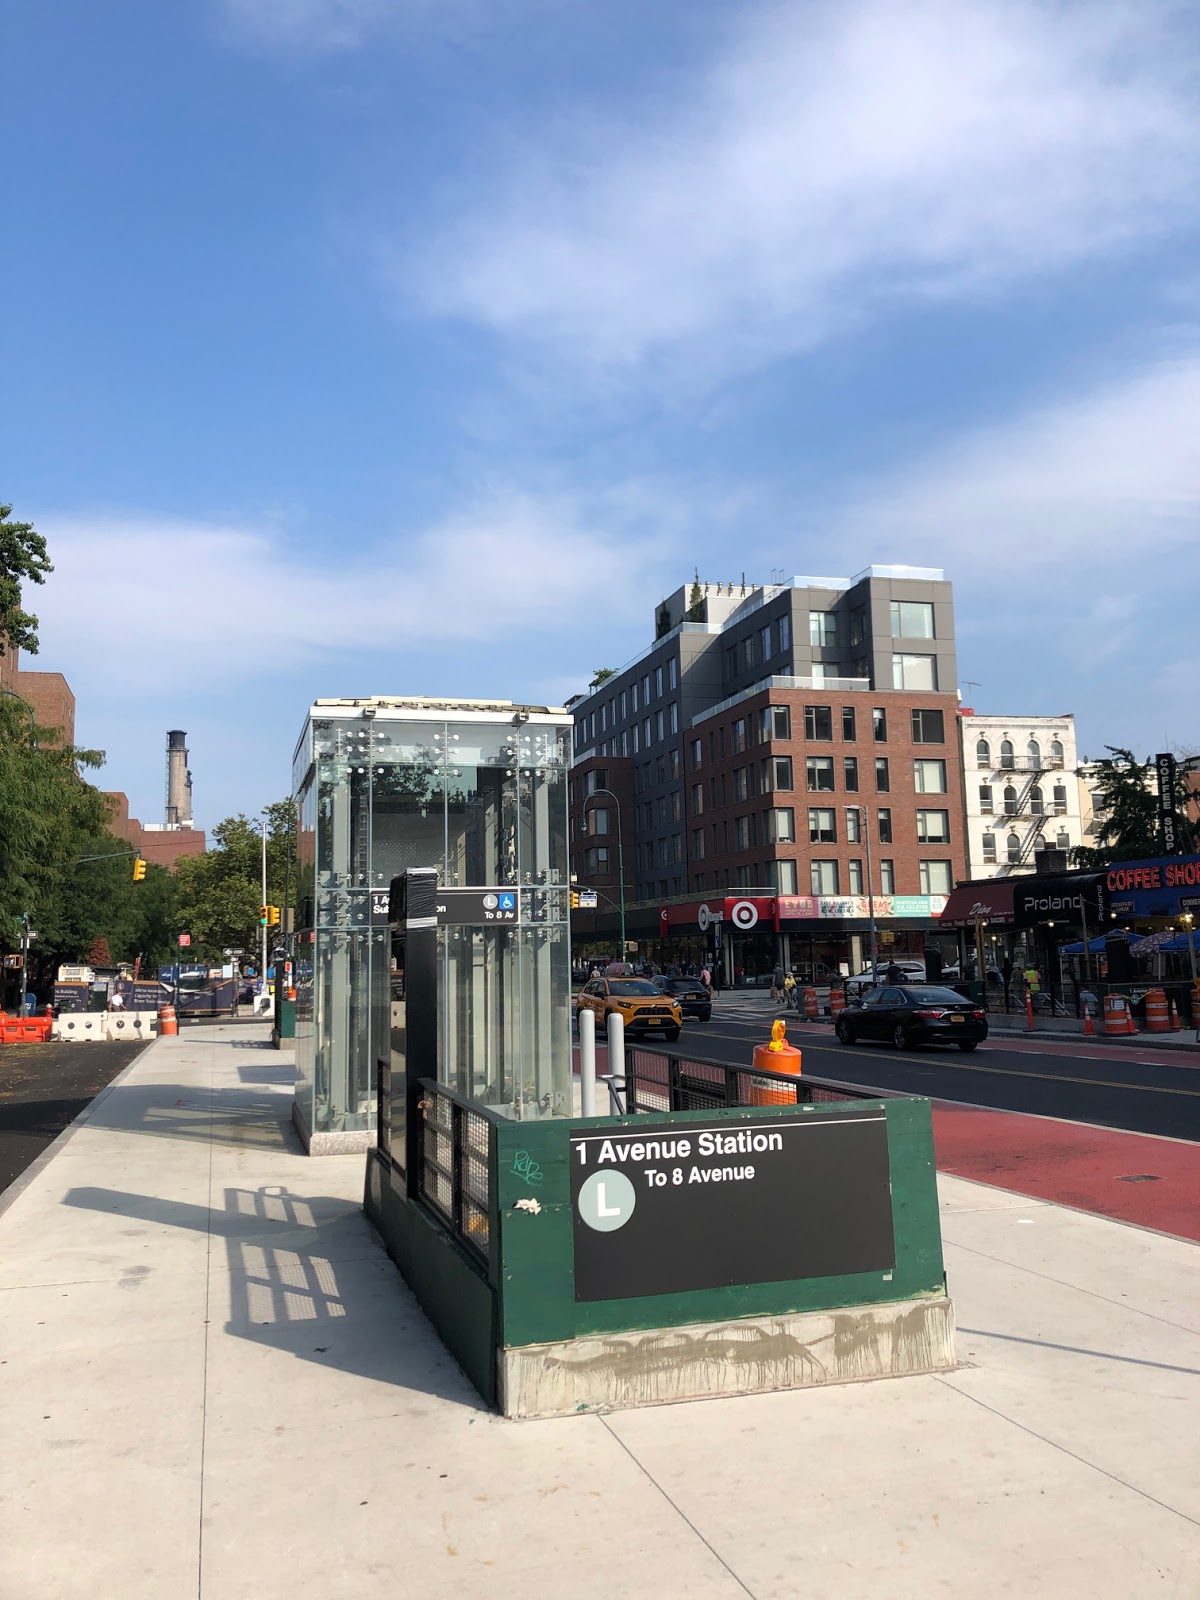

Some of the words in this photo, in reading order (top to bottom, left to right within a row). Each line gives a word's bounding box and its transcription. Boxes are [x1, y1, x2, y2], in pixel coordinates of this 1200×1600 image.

[1159, 758, 1172, 810] COFFEE
[1164, 816, 1175, 850] SHOP
[1107, 866, 1161, 892] COFFEE
[373, 895, 379, 905] 1
[381, 895, 390, 905] A
[861, 901, 888, 909] GEAT
[1024, 895, 1083, 911] Proland
[1096, 885, 1104, 922] Proland
[484, 911, 494, 919] To
[496, 911, 503, 919] 8
[504, 911, 515, 919] Av
[575, 1142, 587, 1165] 1
[597, 1139, 691, 1164] Avenue
[698, 1130, 783, 1156] Station
[644, 1168, 668, 1187] To
[672, 1167, 683, 1186] 8
[688, 1165, 756, 1184] Avenue
[597, 1182, 621, 1217] L
